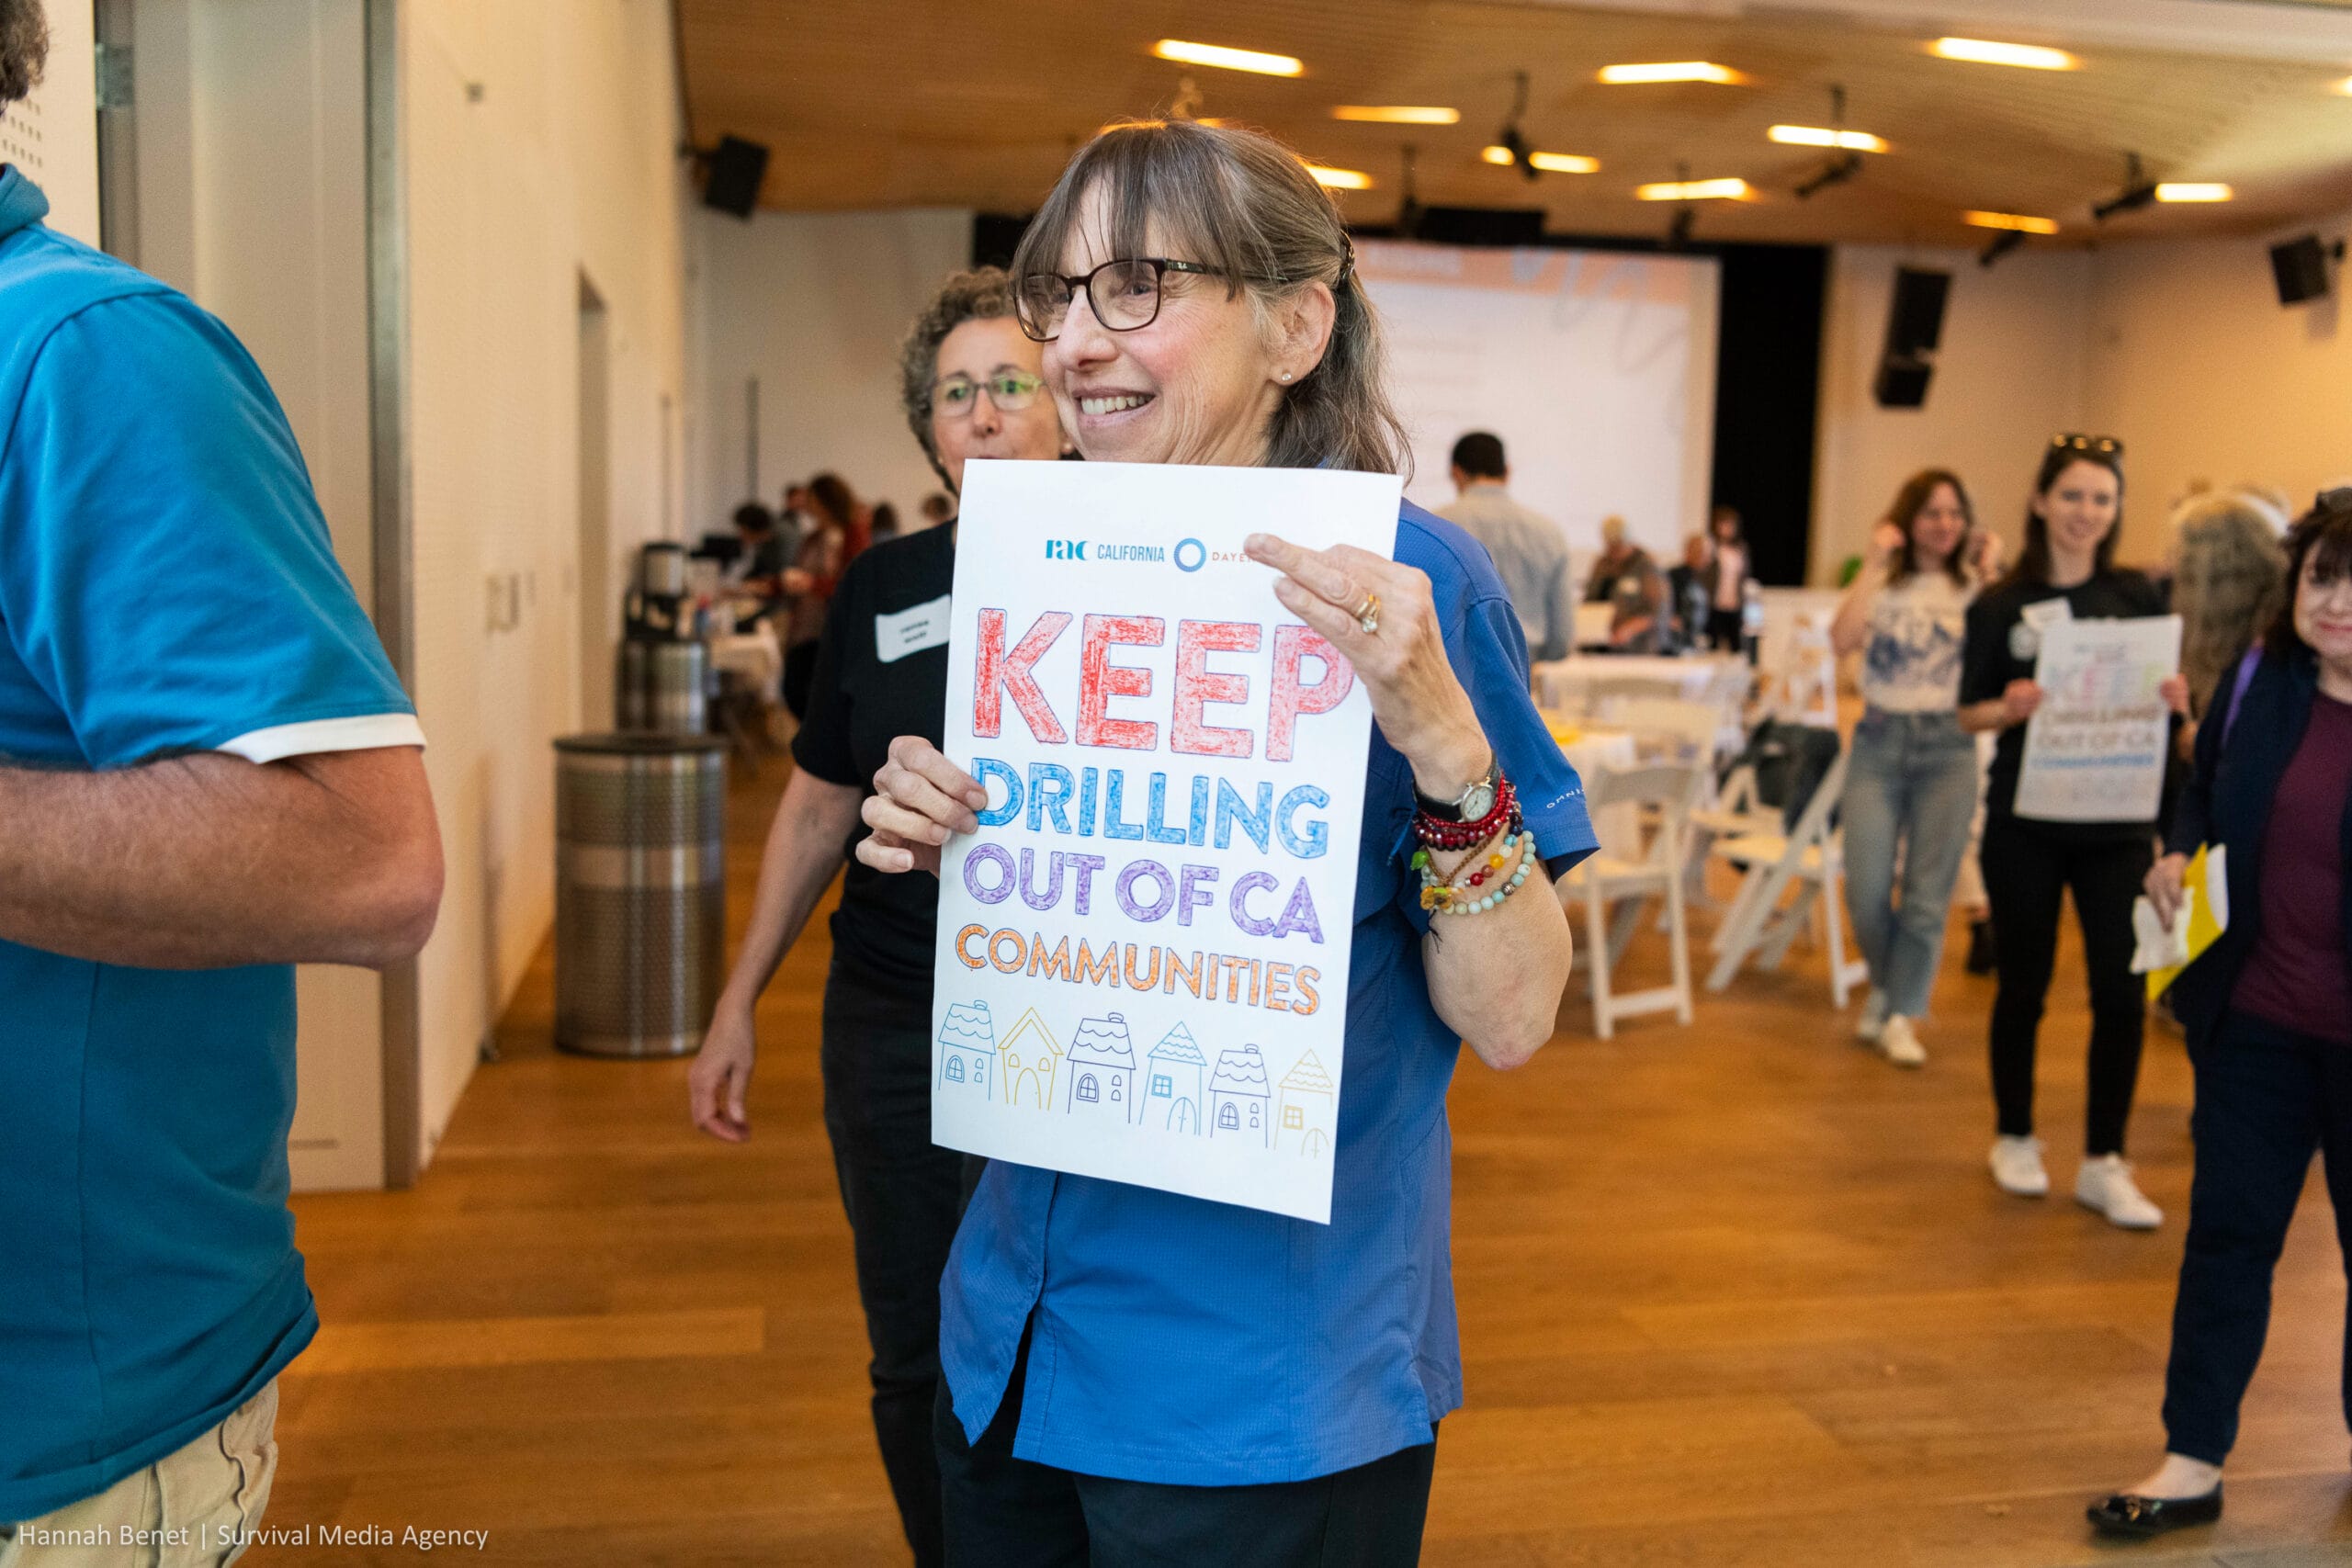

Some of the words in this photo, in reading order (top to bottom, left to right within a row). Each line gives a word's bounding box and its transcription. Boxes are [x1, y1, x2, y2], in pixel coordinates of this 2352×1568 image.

[1046, 539, 1092, 561] rac
[1097, 544, 1165, 562] CALIFORNIA
[1212, 551, 1250, 563] DAYE
[972, 608, 1355, 762] KEEP
[971, 758, 1330, 860] DRILLING
[963, 843, 1105, 915] OUT
[1115, 859, 1219, 926] OF
[1229, 872, 1325, 943] CA
[956, 924, 1321, 1015] COMMUNITIES
